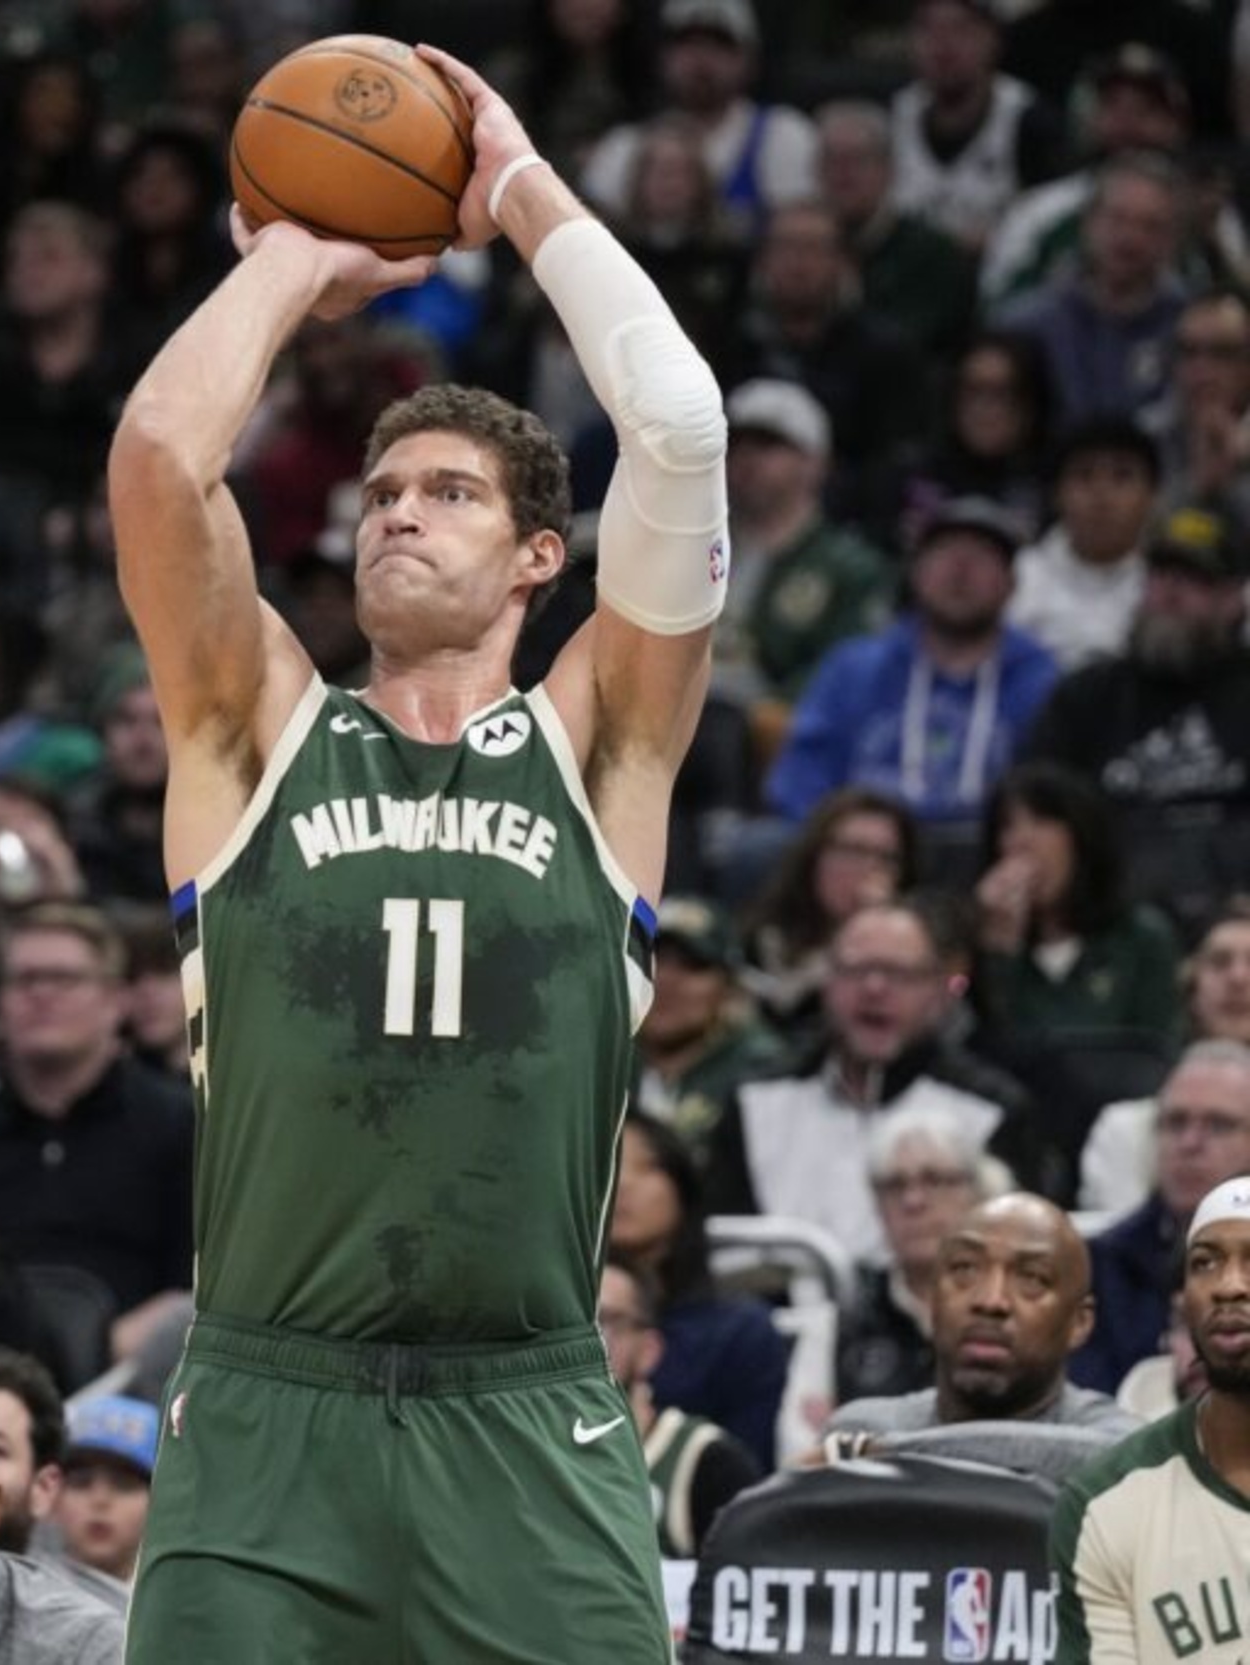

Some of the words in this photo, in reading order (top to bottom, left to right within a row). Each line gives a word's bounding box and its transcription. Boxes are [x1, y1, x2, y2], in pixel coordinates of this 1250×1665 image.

[290, 788, 557, 880] MILWAUKEE
[382, 897, 464, 1037] 11
[711, 1565, 814, 1653] GET
[823, 1569, 931, 1657] THE
